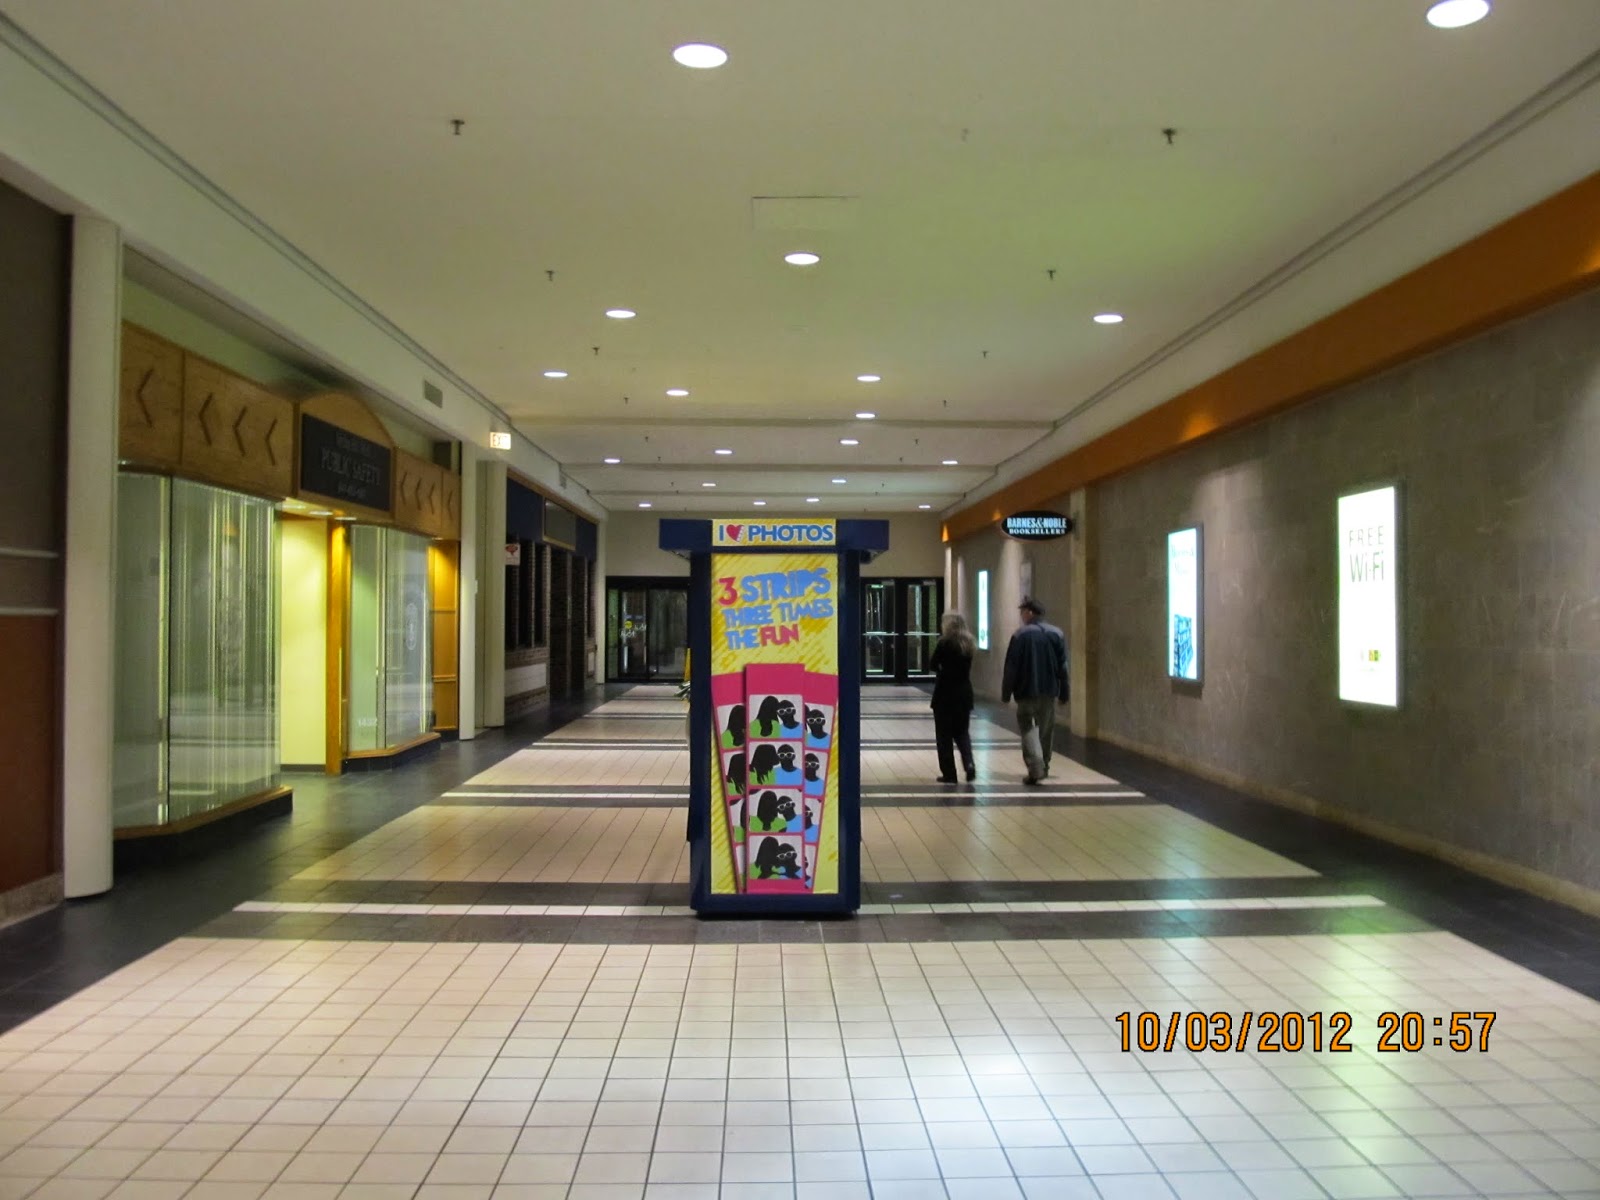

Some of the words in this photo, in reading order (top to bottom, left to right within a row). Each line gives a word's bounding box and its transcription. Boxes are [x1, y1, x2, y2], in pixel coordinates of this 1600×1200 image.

[719, 524, 724, 541] I
[748, 524, 834, 542] PHOTOS
[1349, 525, 1384, 547] FREE
[717, 576, 738, 606] 3
[741, 568, 831, 602] STRIPS
[722, 604, 773, 628] THREE
[778, 598, 834, 622] TIMES
[724, 628, 759, 650] THE
[759, 623, 800, 646] FUN
